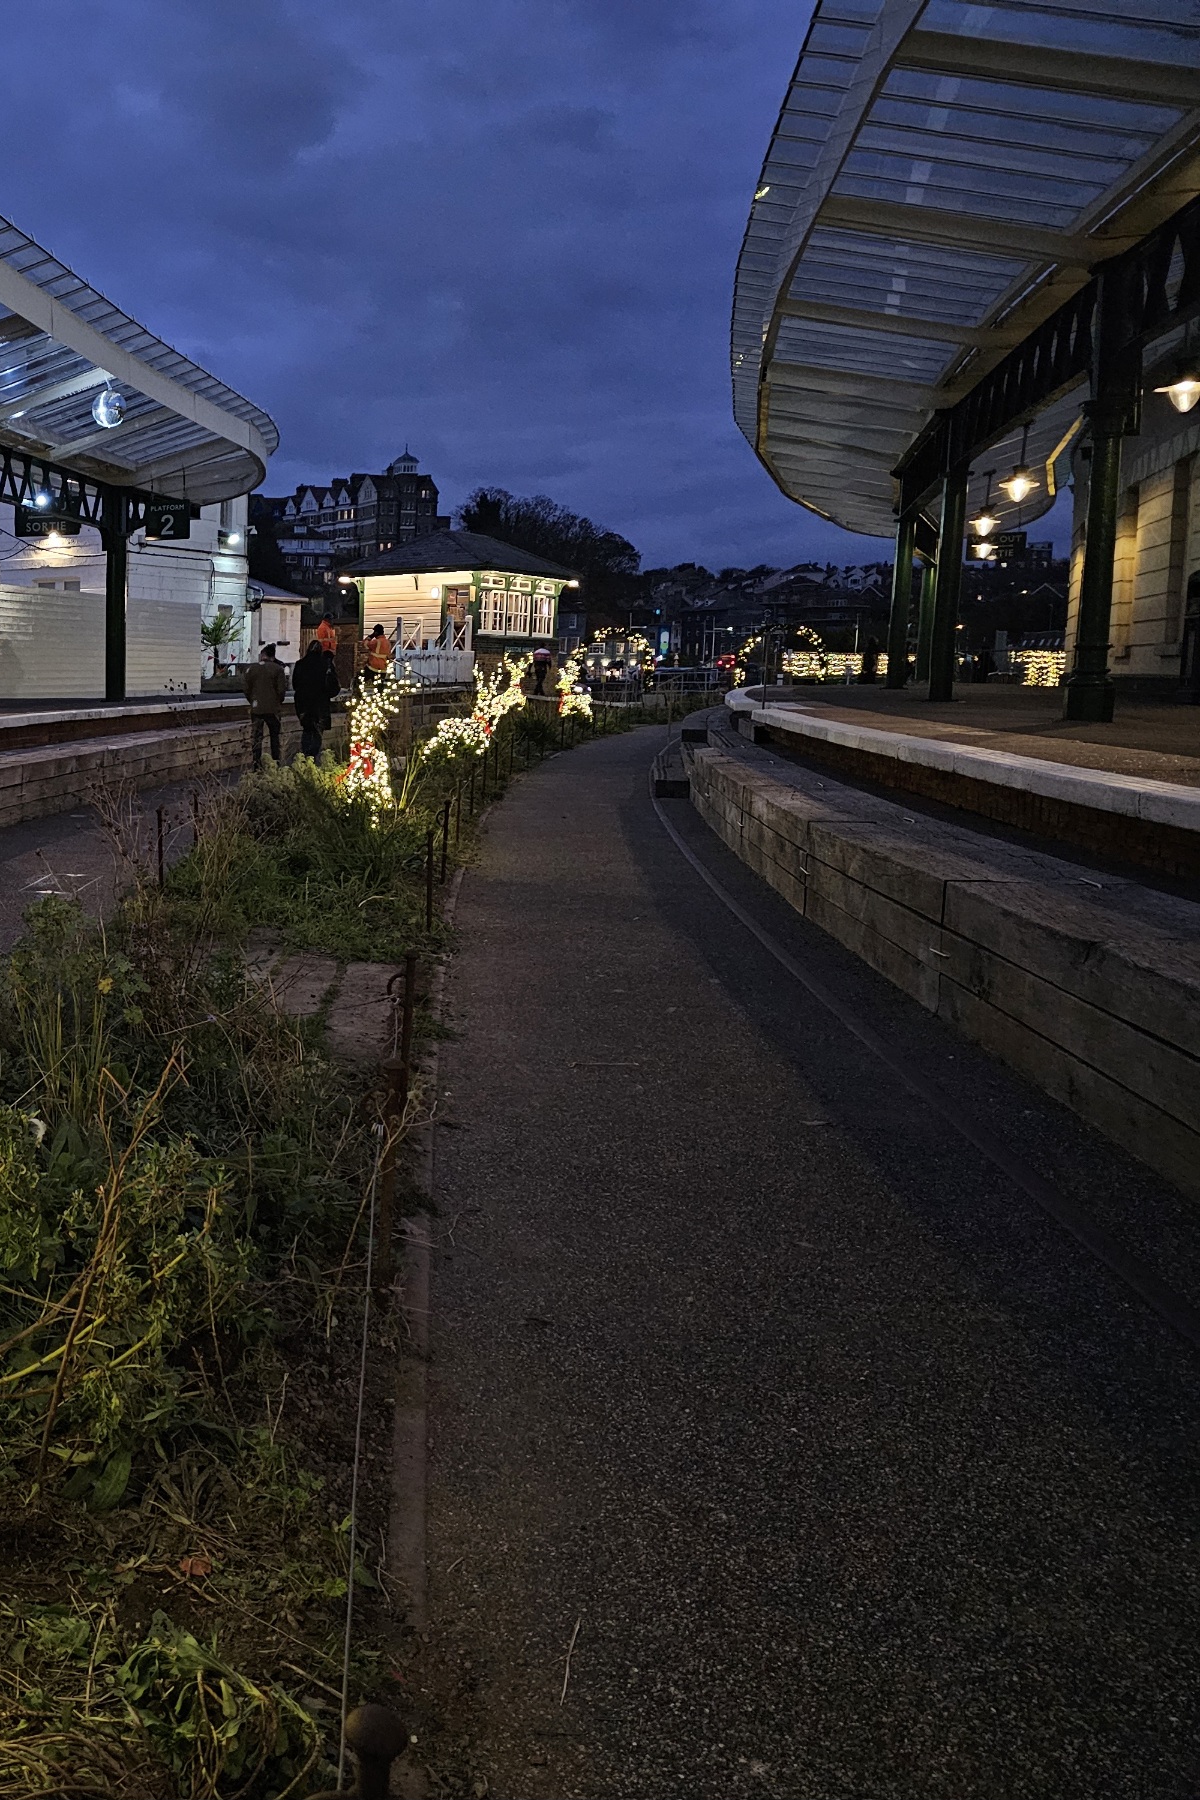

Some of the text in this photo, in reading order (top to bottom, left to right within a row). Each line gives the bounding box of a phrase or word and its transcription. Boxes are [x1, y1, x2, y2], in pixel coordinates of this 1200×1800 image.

[150, 503, 185, 512] PLATFORM
[25, 521, 67, 533] SORTIE
[160, 514, 175, 535] 2
[971, 534, 1023, 544] WY OUT
